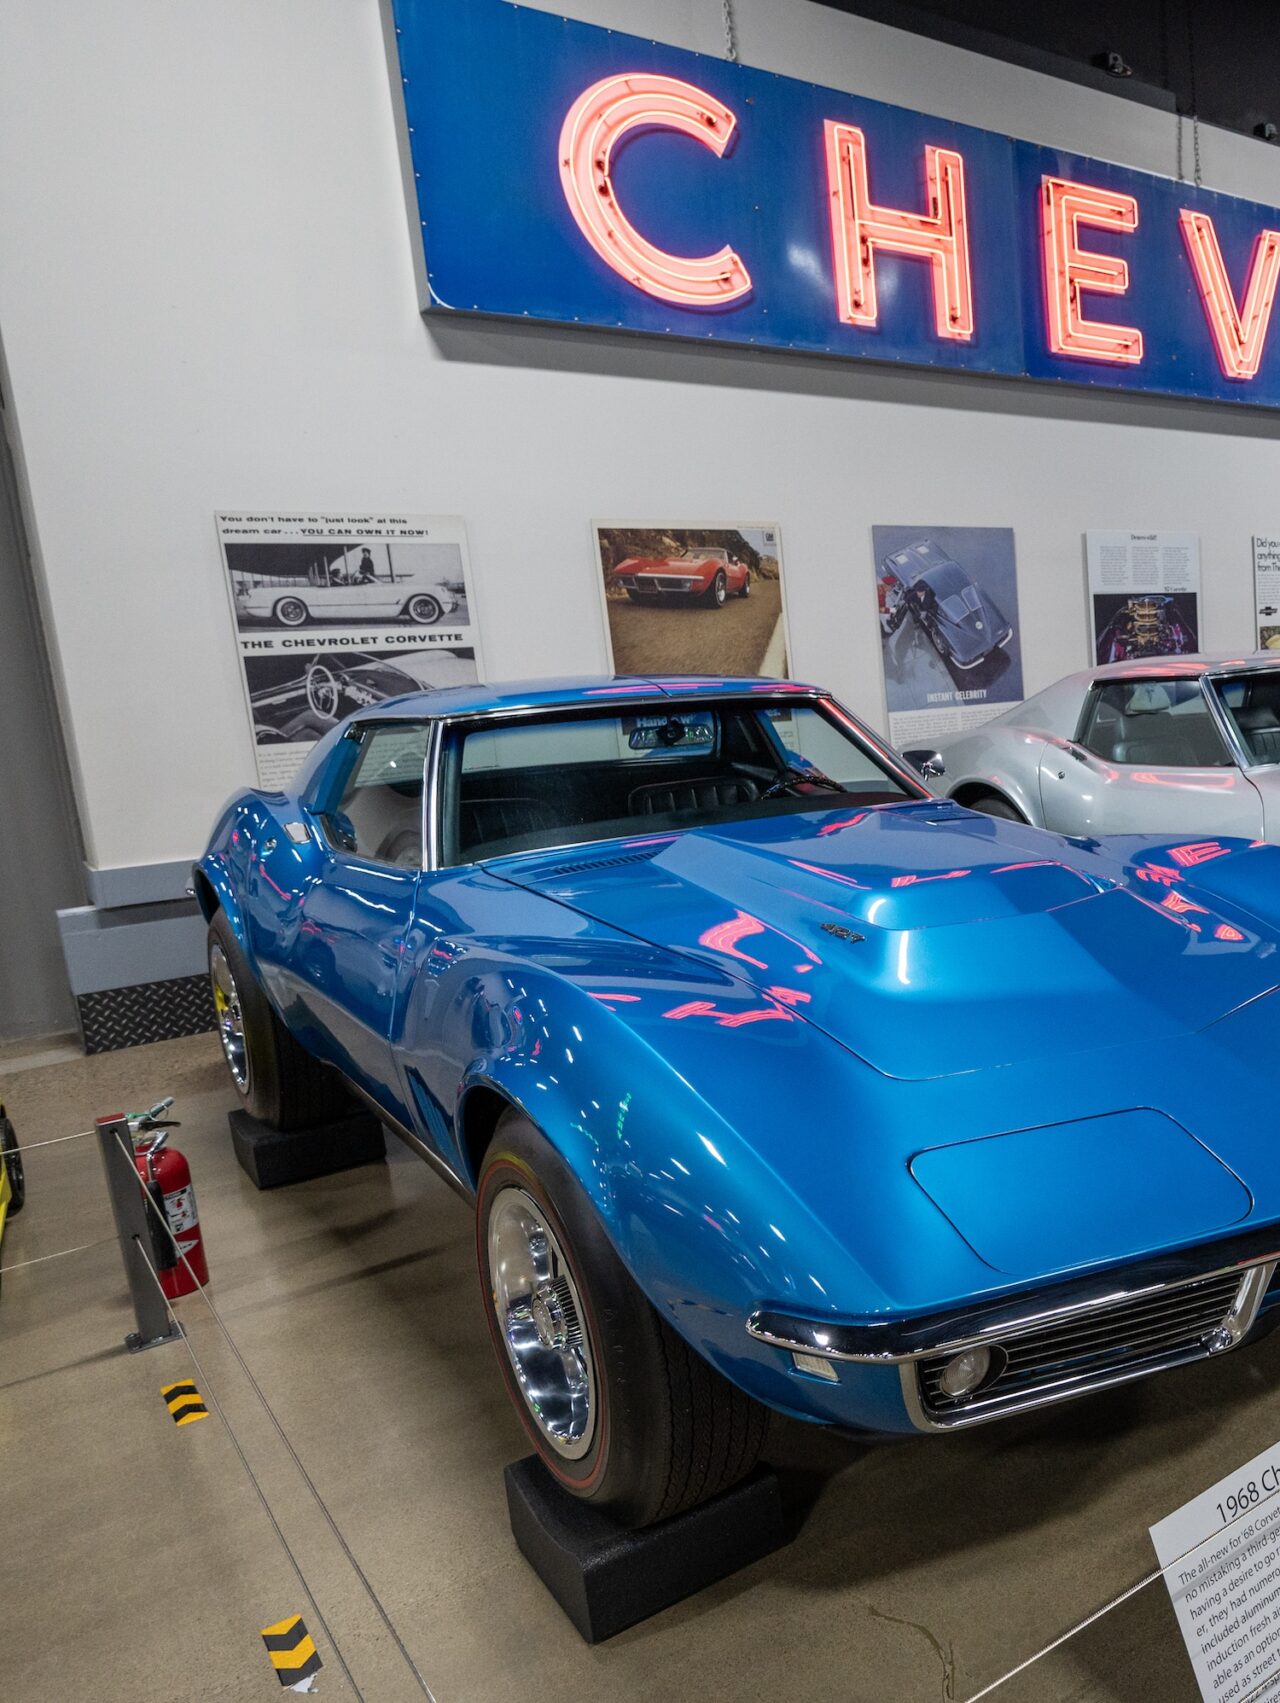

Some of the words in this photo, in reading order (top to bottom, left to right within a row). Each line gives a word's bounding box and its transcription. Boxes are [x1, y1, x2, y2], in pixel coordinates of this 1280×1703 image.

[219, 515, 242, 523] You
[1256, 537, 1268, 548] Did
[1257, 561, 1271, 572] from
[240, 640, 274, 650] THE
[281, 636, 379, 649] CHEVROLET
[385, 633, 464, 644] CORVETTE
[927, 691, 953, 703] INSTANT
[954, 689, 987, 700] CELEBRITY
[820, 922, 867, 944] 427
[1214, 1478, 1260, 1525] 1968
[1178, 1567, 1197, 1586] The
[1197, 1544, 1229, 1573] all-new
[1228, 1535, 1241, 1550] for
[1240, 1523, 1254, 1539] '68
[1184, 1588, 1198, 1604] no
[1198, 1557, 1241, 1594] mistaking
[1241, 1552, 1247, 1562] a
[1189, 1591, 1222, 1621] having
[1221, 1586, 1227, 1597] a
[1226, 1567, 1253, 1592] desire
[1252, 1559, 1264, 1573] to
[1263, 1550, 1275, 1568] go
[1195, 1625, 1208, 1638] er,
[1207, 1606, 1230, 1628] they
[1229, 1589, 1247, 1611] had
[1199, 1616, 1240, 1656] included
[1205, 1632, 1249, 1673] induction
[1248, 1612, 1271, 1638] fresh
[1211, 1667, 1232, 1690] able
[1232, 1659, 1243, 1673] as
[1243, 1649, 1255, 1665] an
[1240, 1673, 1251, 1688] as
[1252, 1650, 1276, 1679] street
